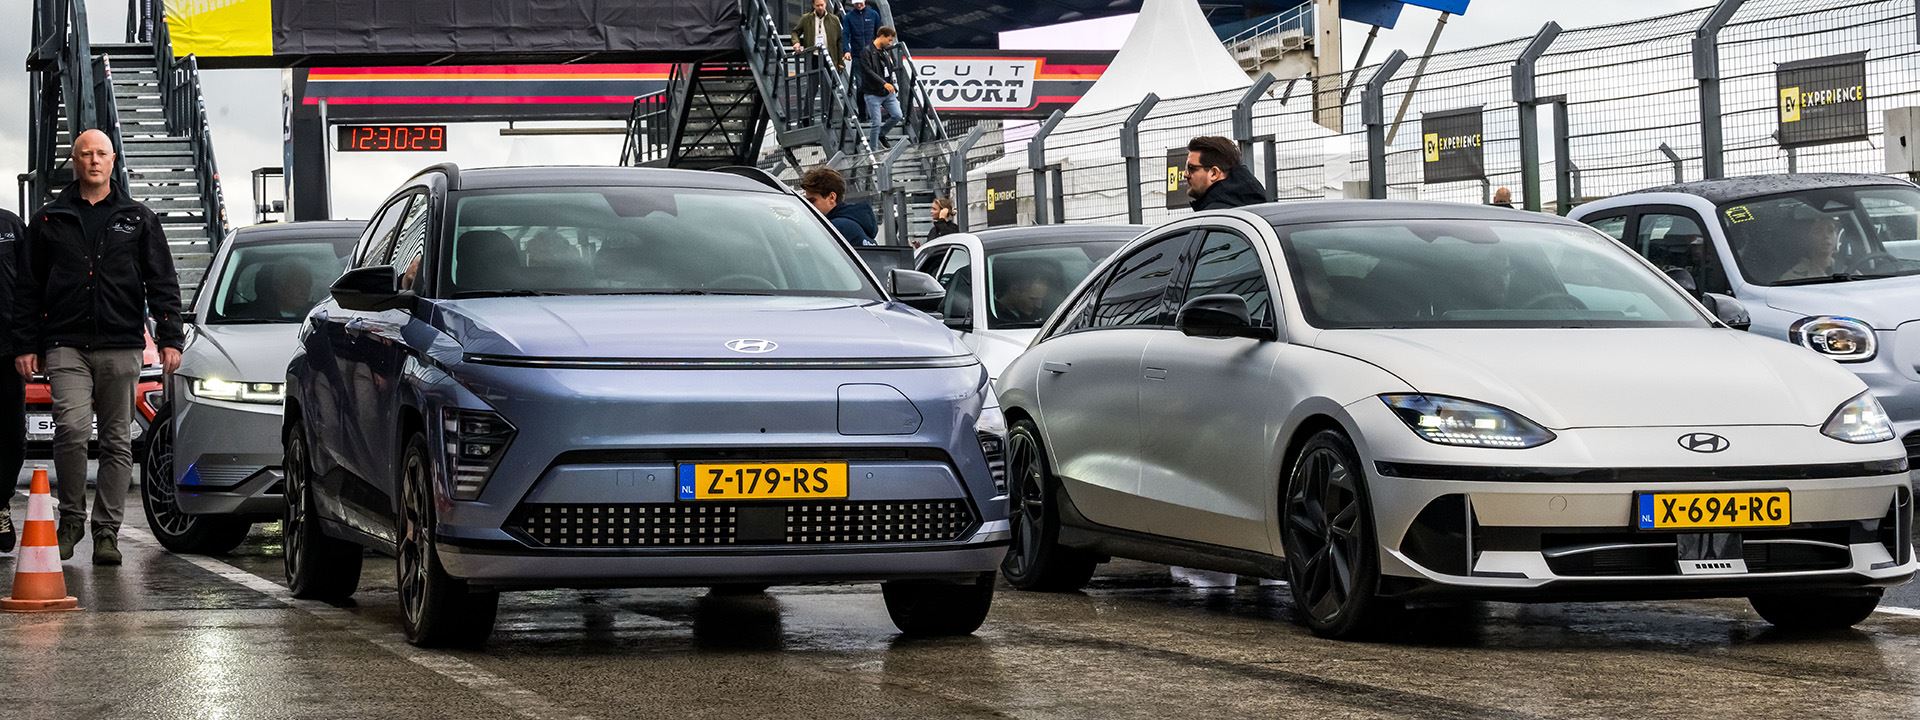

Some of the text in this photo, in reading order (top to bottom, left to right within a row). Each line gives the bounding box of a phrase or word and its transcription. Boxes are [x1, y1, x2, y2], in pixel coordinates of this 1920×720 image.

[920, 65, 1024, 76] CUIT
[917, 79, 1024, 102] VOORT
[1801, 85, 1863, 107] EXPERIENCE
[351, 127, 443, 150] 12:30:29
[1439, 133, 1481, 150] EXPERIENCE
[707, 468, 829, 494] Z-179-RS
[1662, 497, 1781, 523] X-694-RG
